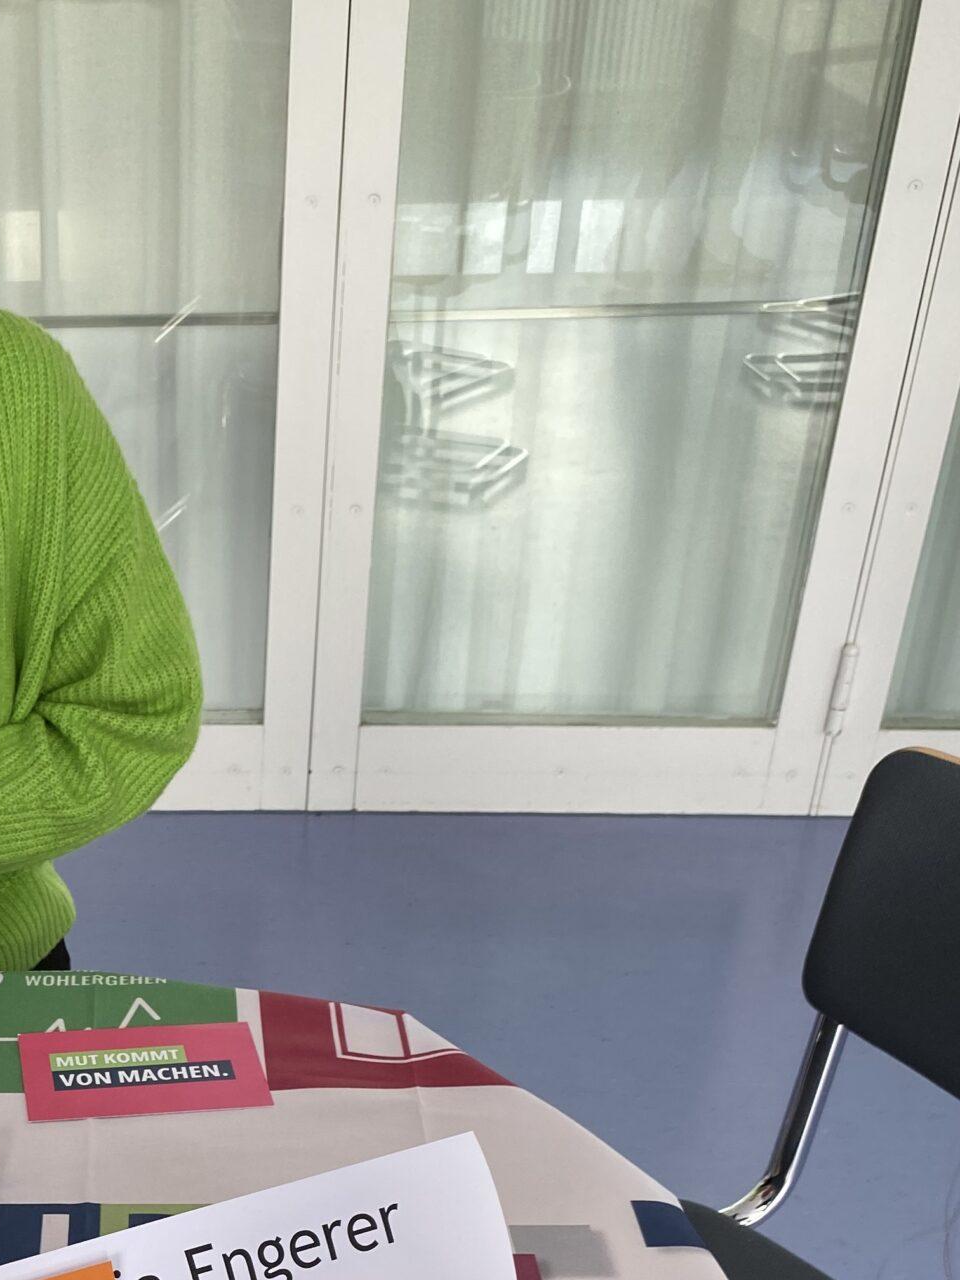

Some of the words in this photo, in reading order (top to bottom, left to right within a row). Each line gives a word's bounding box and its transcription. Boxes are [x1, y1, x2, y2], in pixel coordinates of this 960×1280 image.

[56, 1054, 100, 1068] MUT
[104, 1049, 179, 1064] KOMMT
[59, 1072, 112, 1087] VON
[118, 1064, 229, 1084] MACHEN.
